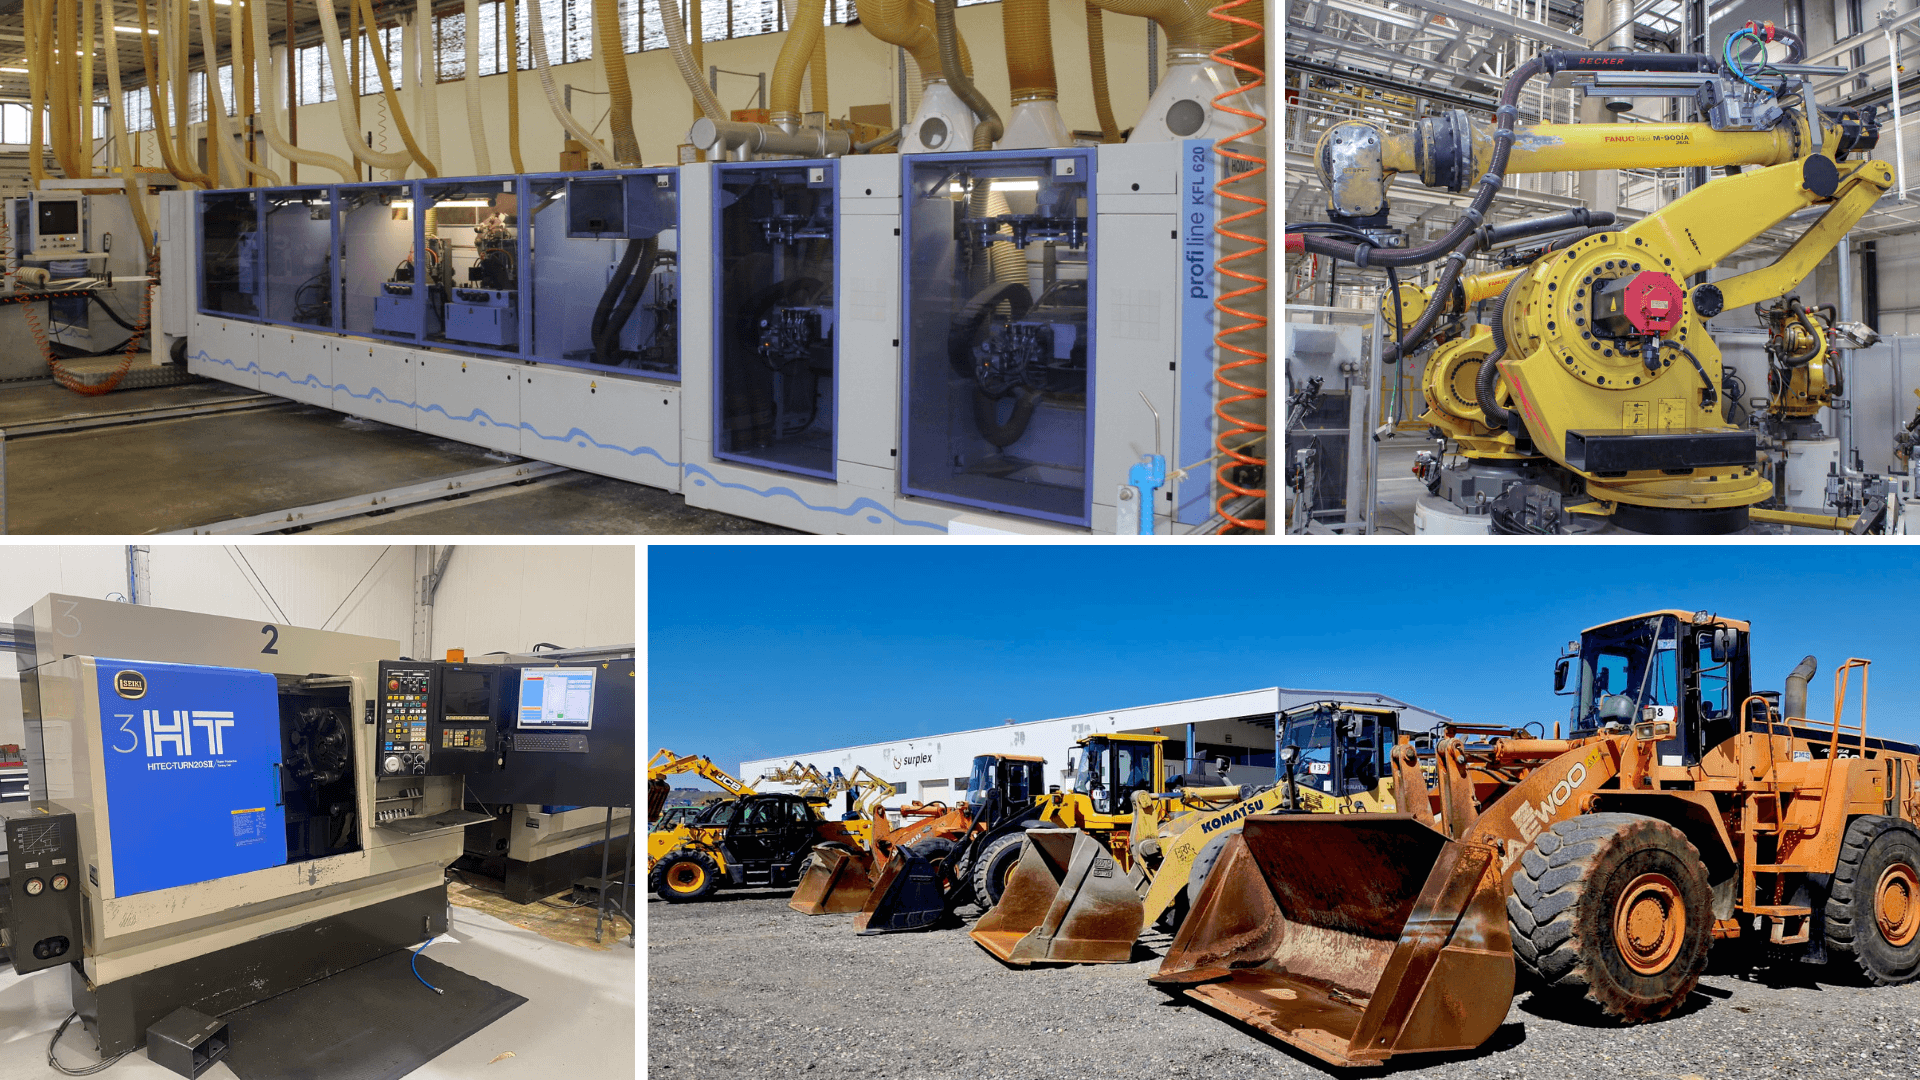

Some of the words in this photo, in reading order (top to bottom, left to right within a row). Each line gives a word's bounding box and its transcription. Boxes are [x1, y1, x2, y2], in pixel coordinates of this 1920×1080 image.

[1579, 57, 1624, 65] BECKER
[1192, 146, 1205, 173] 620
[1231, 159, 1254, 173] HOMAG
[1192, 176, 1204, 205] KFL
[1186, 212, 1204, 246] line
[1186, 251, 1208, 299] profi
[56, 599, 82, 638] 3
[260, 624, 279, 655] 2
[123, 680, 142, 688] SEIKI
[112, 714, 138, 753] 3
[143, 710, 235, 757] HT
[903, 752, 933, 768] surplex
[715, 773, 742, 792] JCB
[1201, 799, 1264, 834] KOMATSU
[1501, 762, 1587, 876] AEWOO
